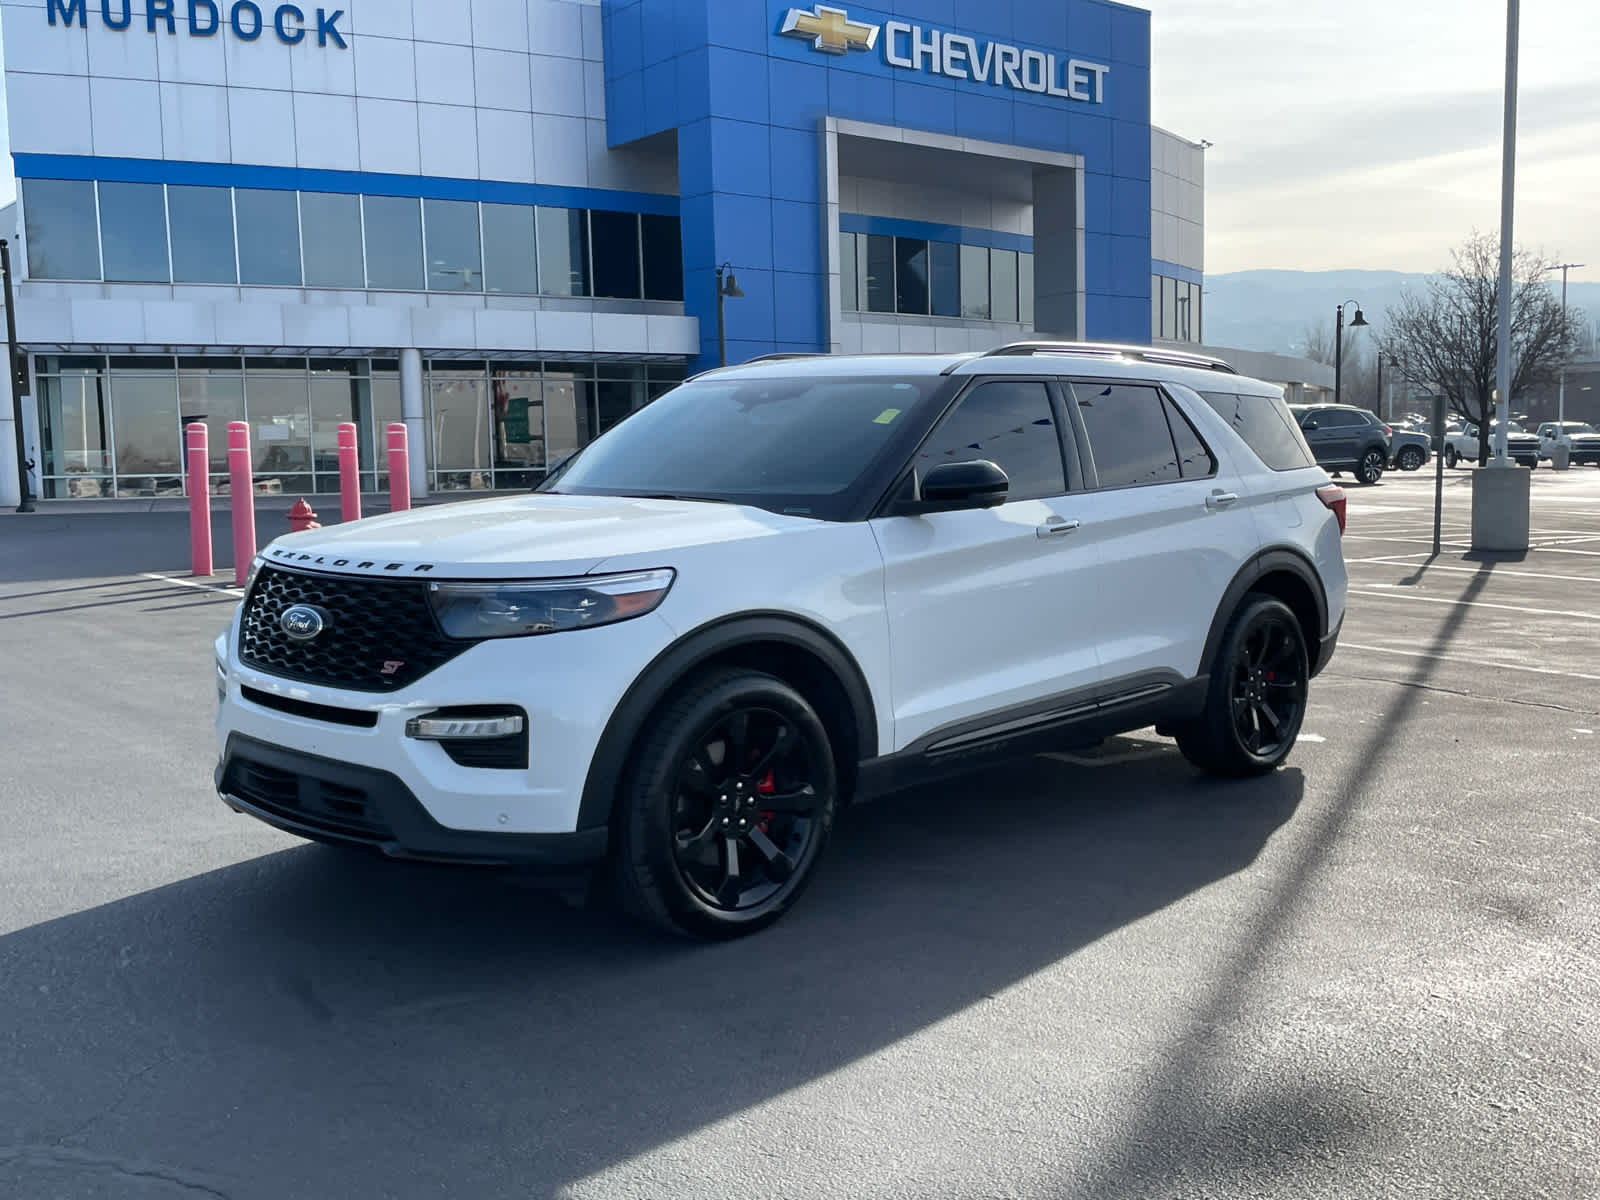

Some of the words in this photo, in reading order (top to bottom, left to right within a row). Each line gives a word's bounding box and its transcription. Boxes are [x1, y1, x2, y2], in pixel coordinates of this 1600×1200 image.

[47, 0, 347, 49] MURDOCK
[886, 21, 1110, 103] CHEVROLET
[272, 550, 434, 572] EXPLORER
[287, 612, 311, 630] Ford
[380, 660, 405, 675] ST
